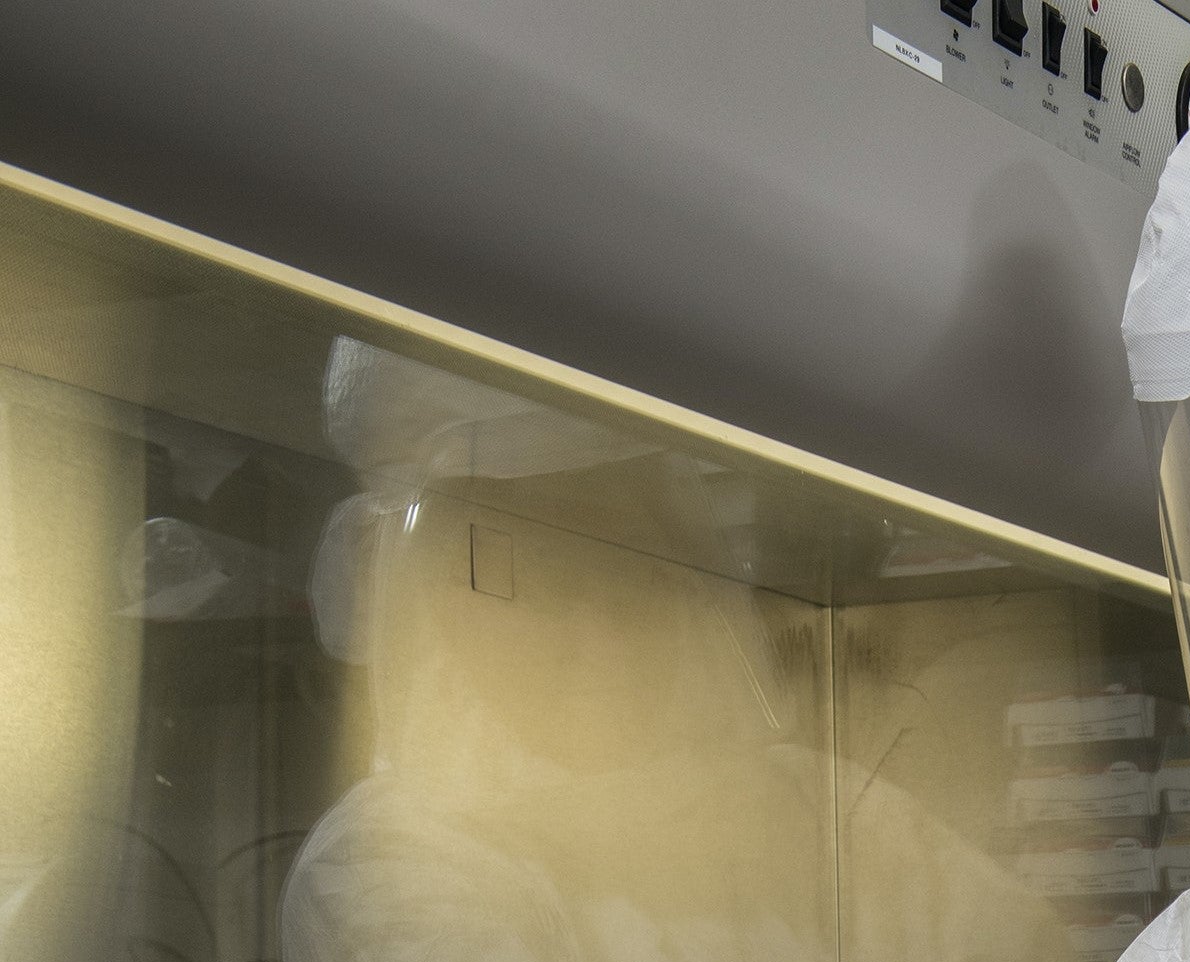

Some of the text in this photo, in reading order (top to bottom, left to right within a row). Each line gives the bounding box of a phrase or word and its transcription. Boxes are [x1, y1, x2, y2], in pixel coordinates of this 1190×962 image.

[945, 45, 967, 63] BLOWER
[1000, 76, 1014, 89] LIGHT
[1042, 99, 1059, 115] OUTLET
[1083, 120, 1101, 135] WINDOW
[1085, 130, 1099, 144] ALARM
[1122, 152, 1141, 168] CONTROL
